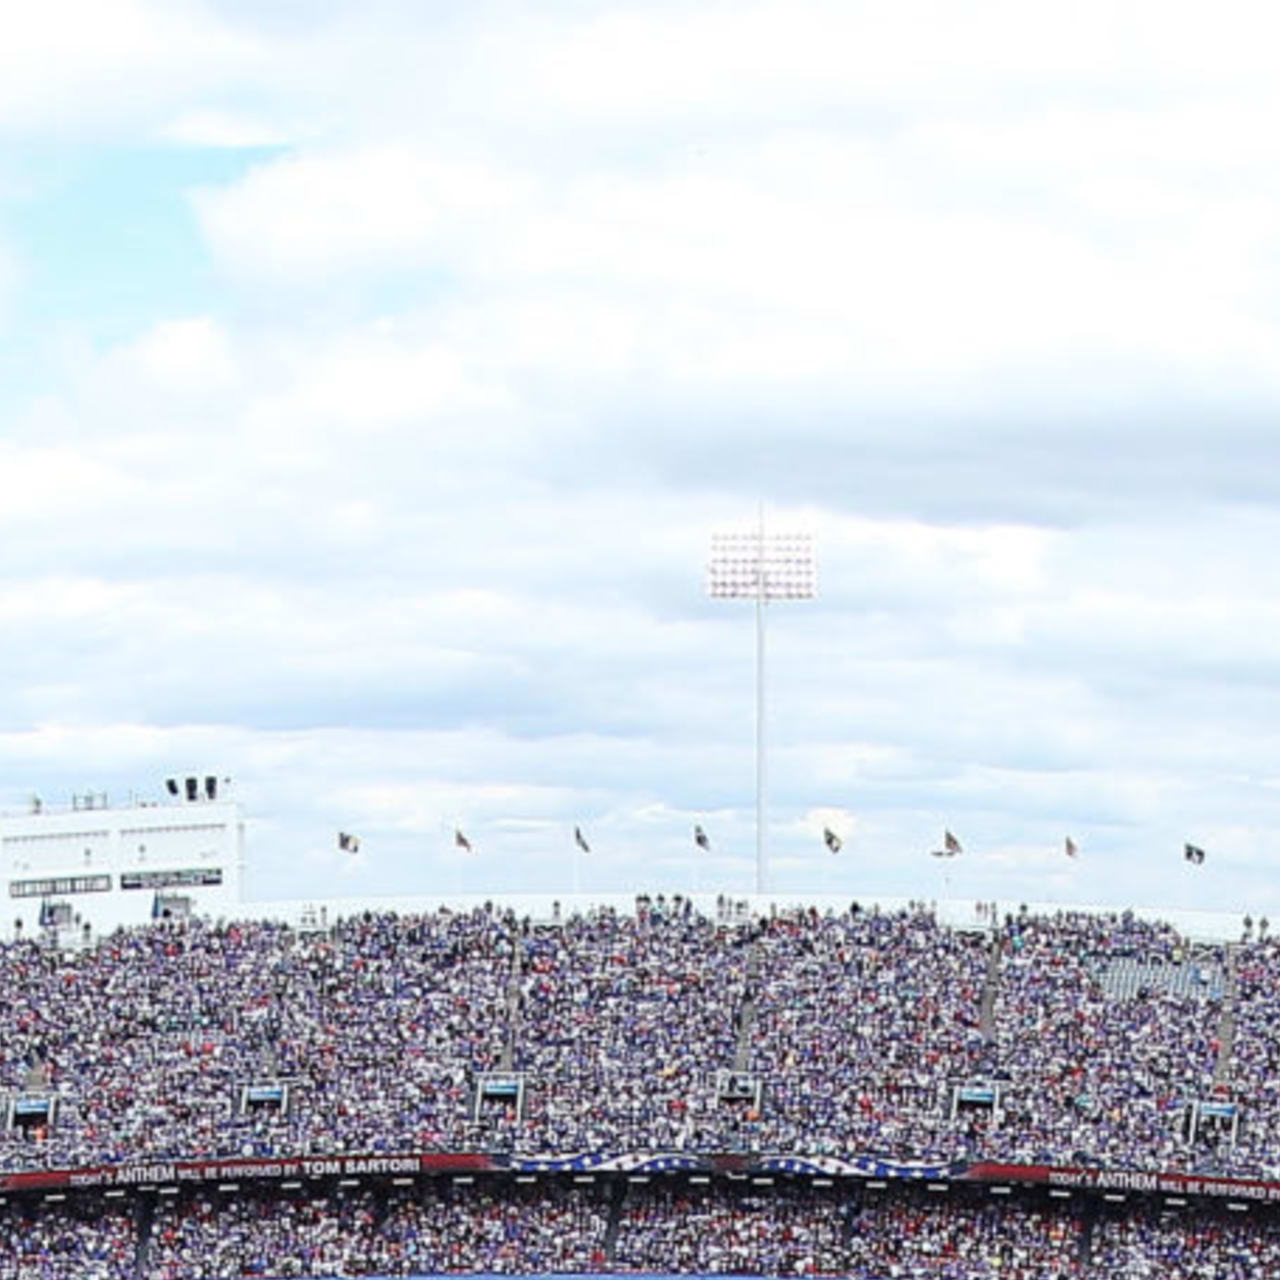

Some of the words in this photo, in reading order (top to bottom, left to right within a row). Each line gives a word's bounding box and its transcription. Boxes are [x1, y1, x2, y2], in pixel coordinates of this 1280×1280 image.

[116, 1164, 175, 1184] ANTHEM
[301, 1160, 341, 1174] TOM
[1096, 1171, 1158, 1190] ANTHEM
